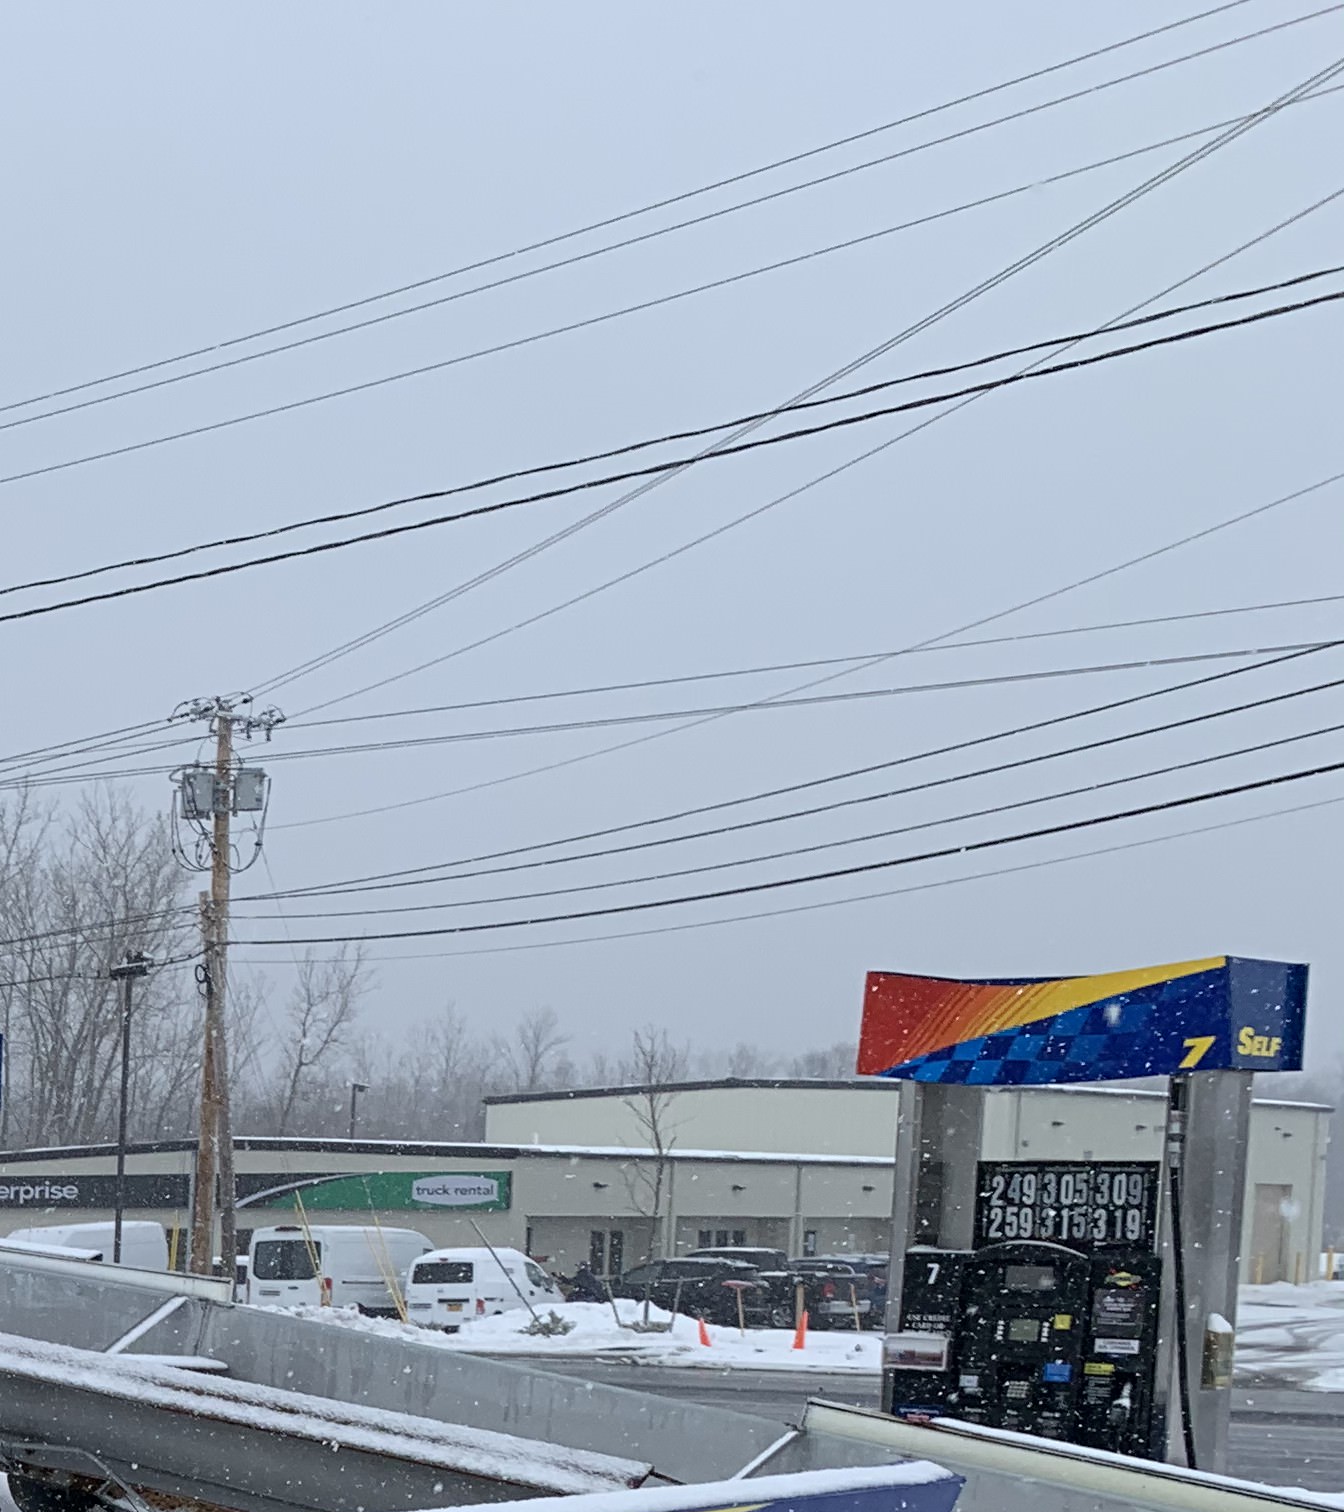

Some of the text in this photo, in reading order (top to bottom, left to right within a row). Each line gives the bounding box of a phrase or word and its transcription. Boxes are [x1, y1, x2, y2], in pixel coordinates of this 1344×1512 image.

[1178, 1035, 1216, 1069] 7
[416, 1184, 494, 1196] truck rental
[927, 1263, 940, 1285] 7
